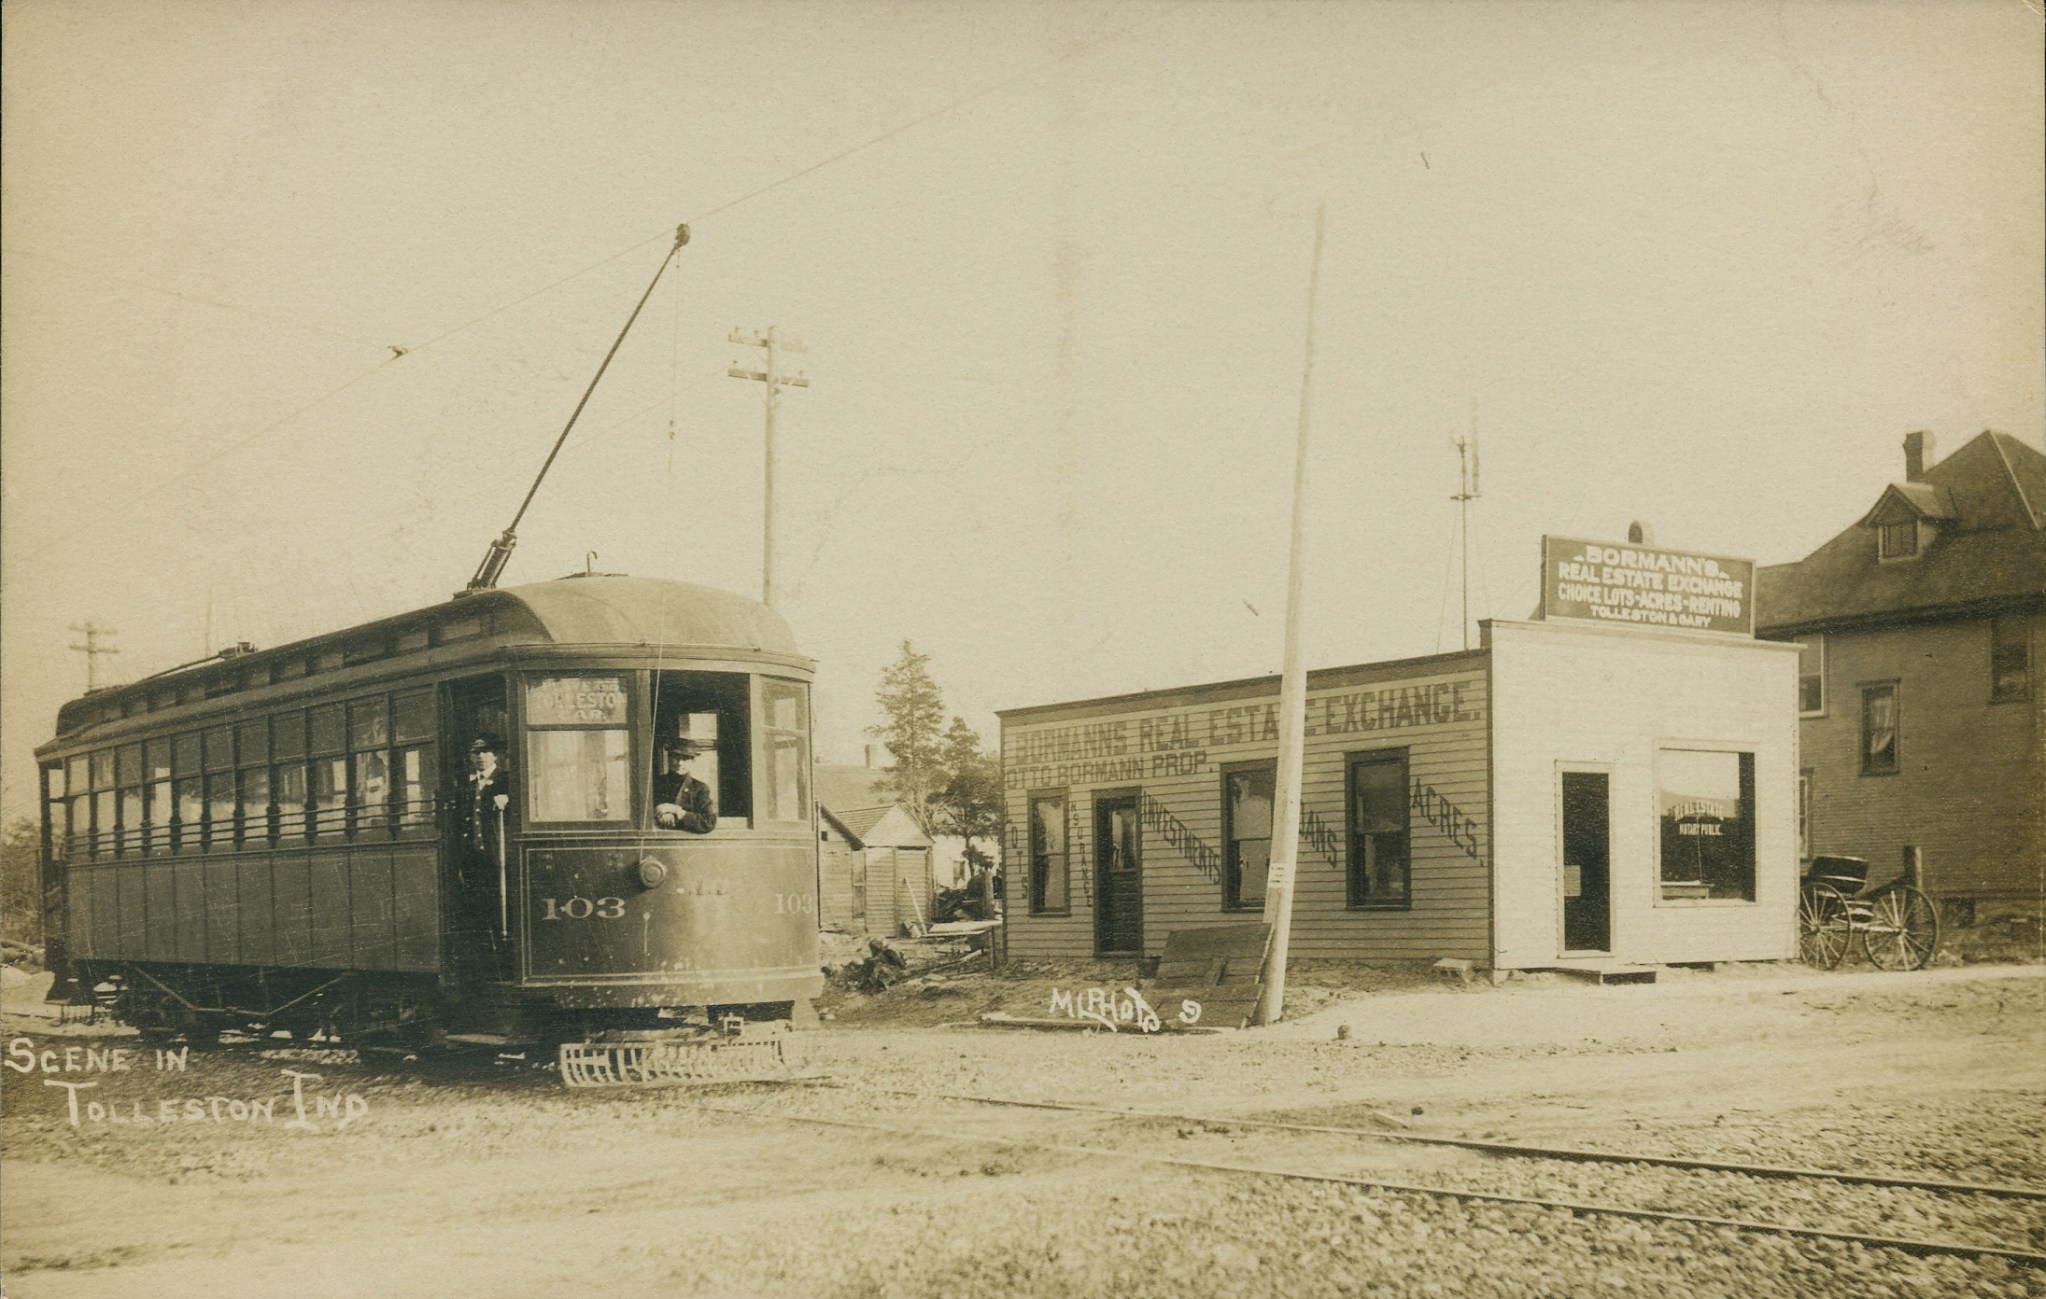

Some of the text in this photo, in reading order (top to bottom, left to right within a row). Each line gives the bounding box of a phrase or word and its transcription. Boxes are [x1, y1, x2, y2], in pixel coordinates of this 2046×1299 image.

[1558, 582, 1601, 603] CHOICE
[1559, 561, 1743, 598] REAL ESTATE EXCHANGE
[1590, 604, 1667, 624] TOLLESTON
[1679, 614, 1712, 628] GARY
[1016, 720, 1127, 765] BORMANNS
[1140, 713, 1200, 752] REAL
[1209, 698, 1317, 746] ESTAE
[1006, 765, 1050, 789] OTTO
[1057, 756, 1144, 786] BORMANN
[1004, 801, 1028, 899] LOTS
[1142, 790, 1221, 885] INVESTMENTS
[541, 897, 626, 921] 103
[774, 893, 813, 915] 103
